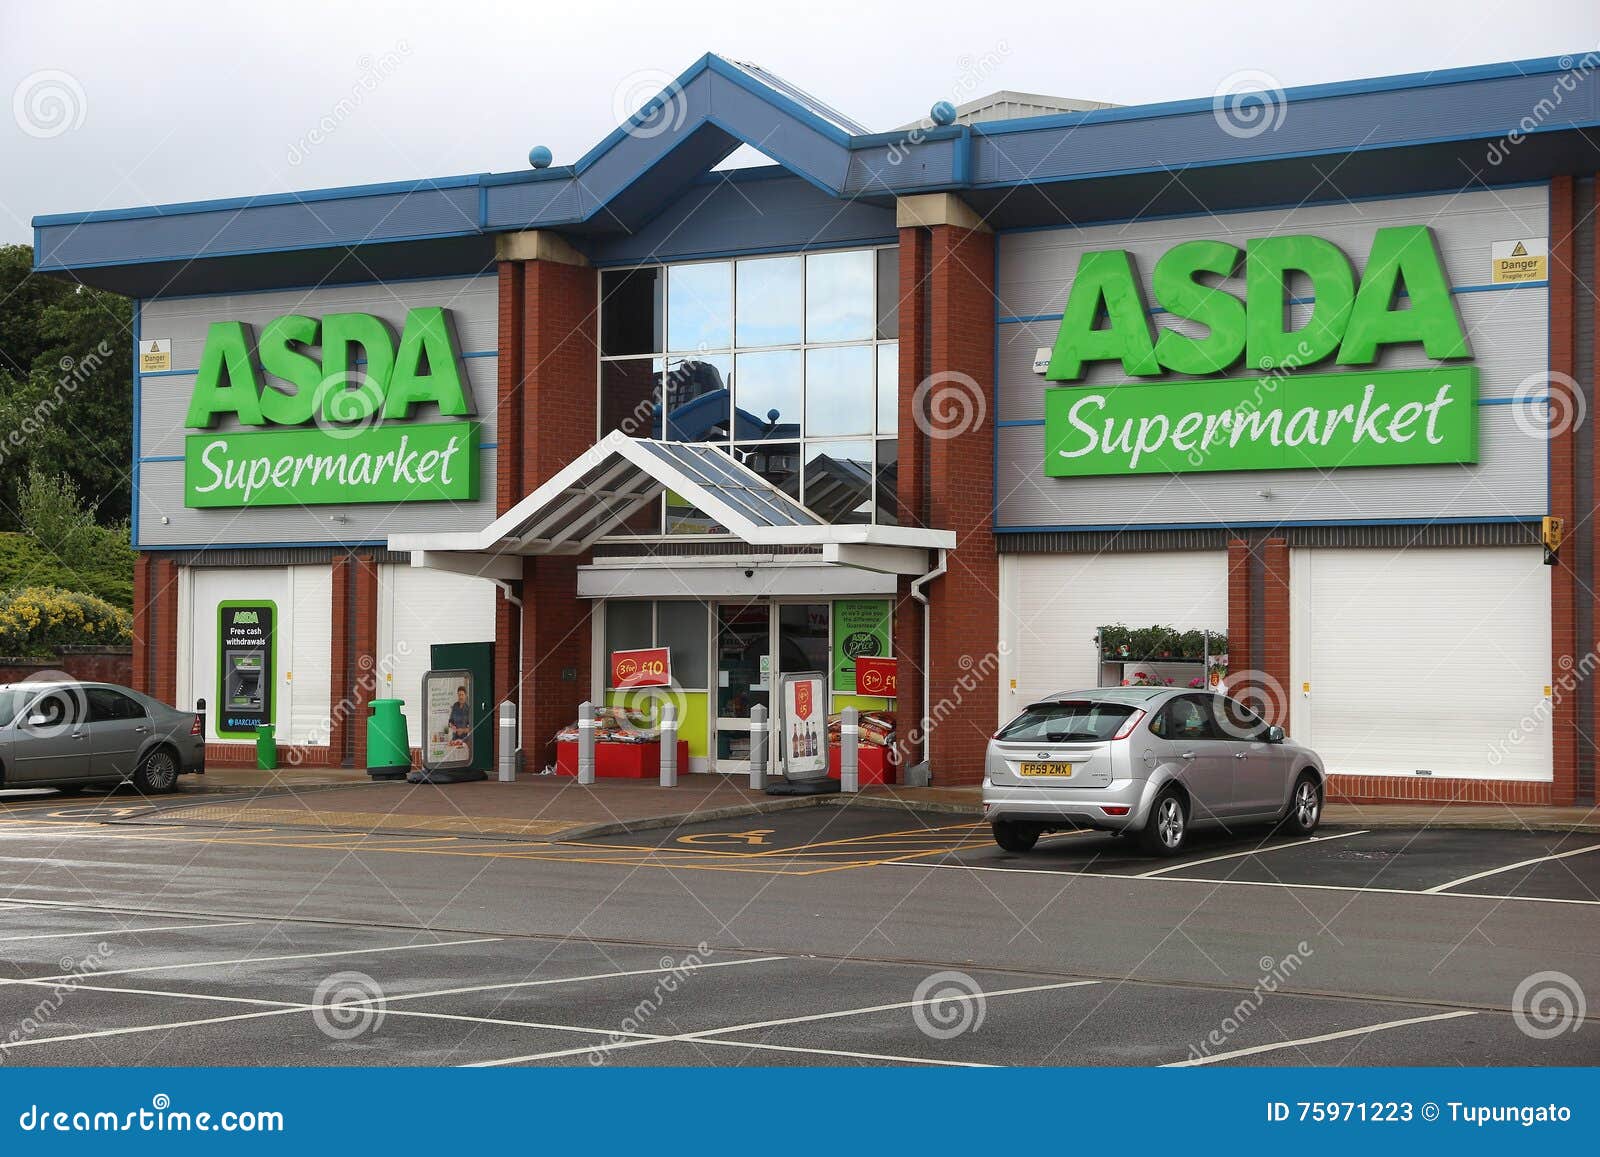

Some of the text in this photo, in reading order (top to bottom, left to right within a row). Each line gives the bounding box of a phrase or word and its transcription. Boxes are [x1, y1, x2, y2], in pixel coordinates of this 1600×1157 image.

[1501, 260, 1537, 269] Danger
[1046, 225, 1474, 381] ASDA
[185, 307, 477, 428] ASDA
[1059, 384, 1455, 469] Supermarket
[195, 436, 460, 502] Supermarket
[233, 611, 259, 624] ASDA
[246, 627, 262, 635] cash
[226, 638, 266, 646] withdrawals
[642, 660, 663, 676] £10
[1023, 764, 1067, 774] FP59 ZMX
